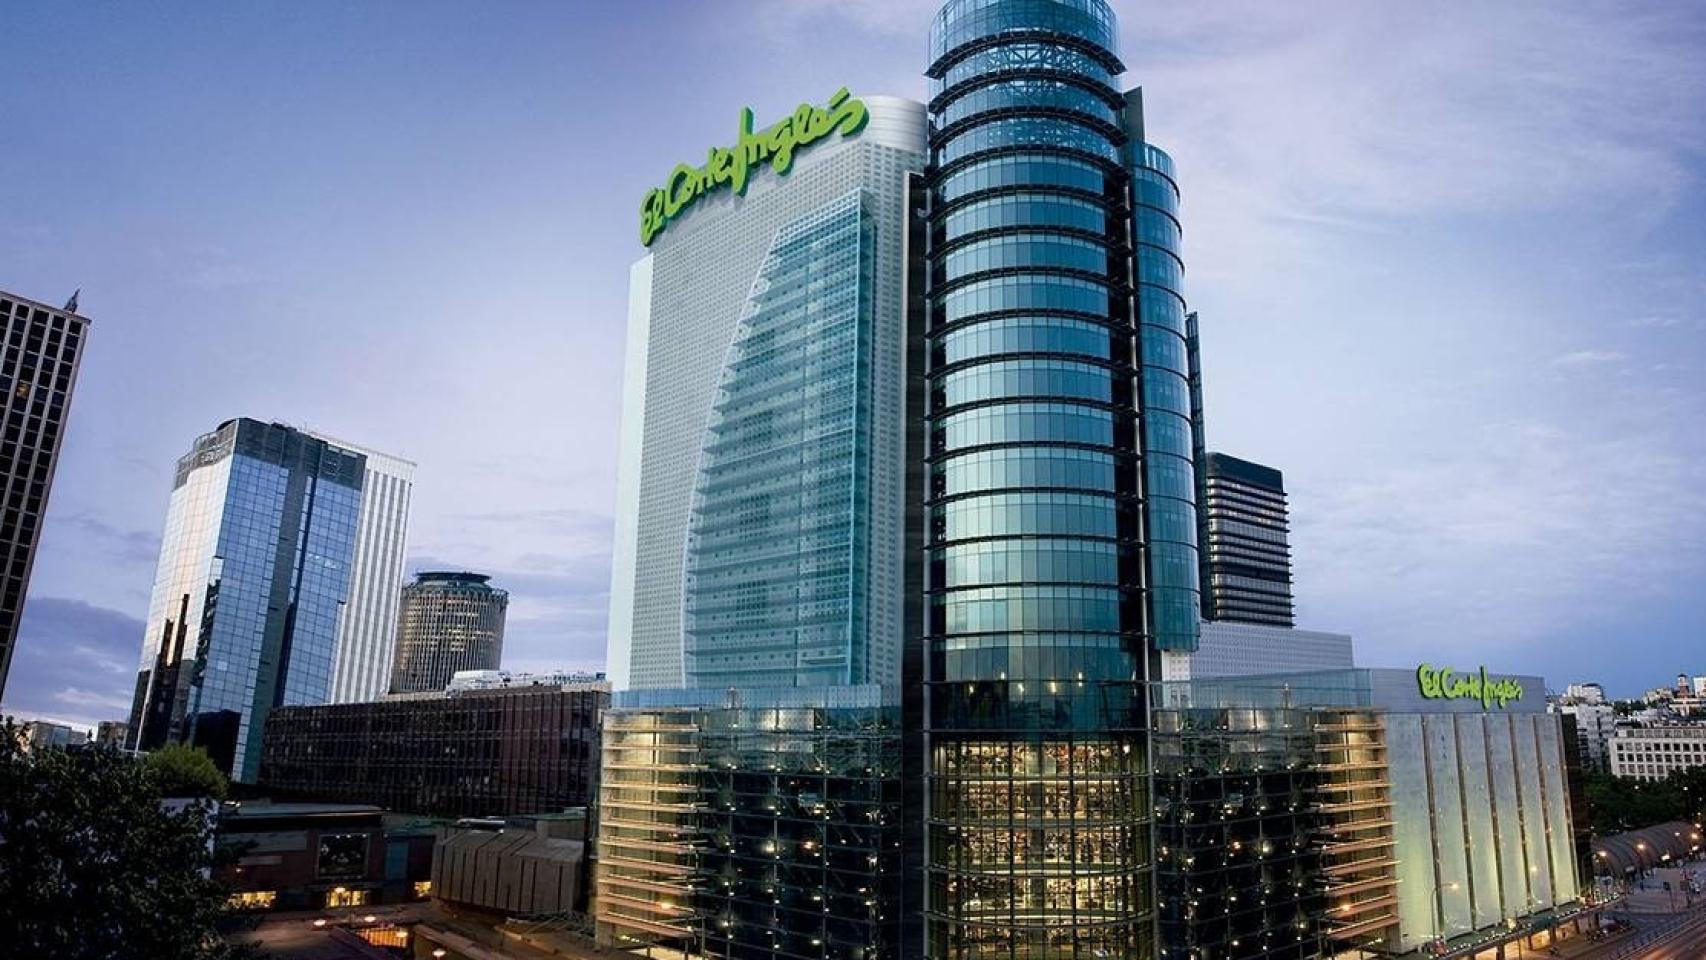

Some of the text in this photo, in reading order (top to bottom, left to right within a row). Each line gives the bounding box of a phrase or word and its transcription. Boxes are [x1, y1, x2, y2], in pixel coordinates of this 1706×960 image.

[640, 87, 869, 246] El Corte Inglés
[1417, 663, 1441, 698] El
[1441, 665, 1480, 699] Corte
